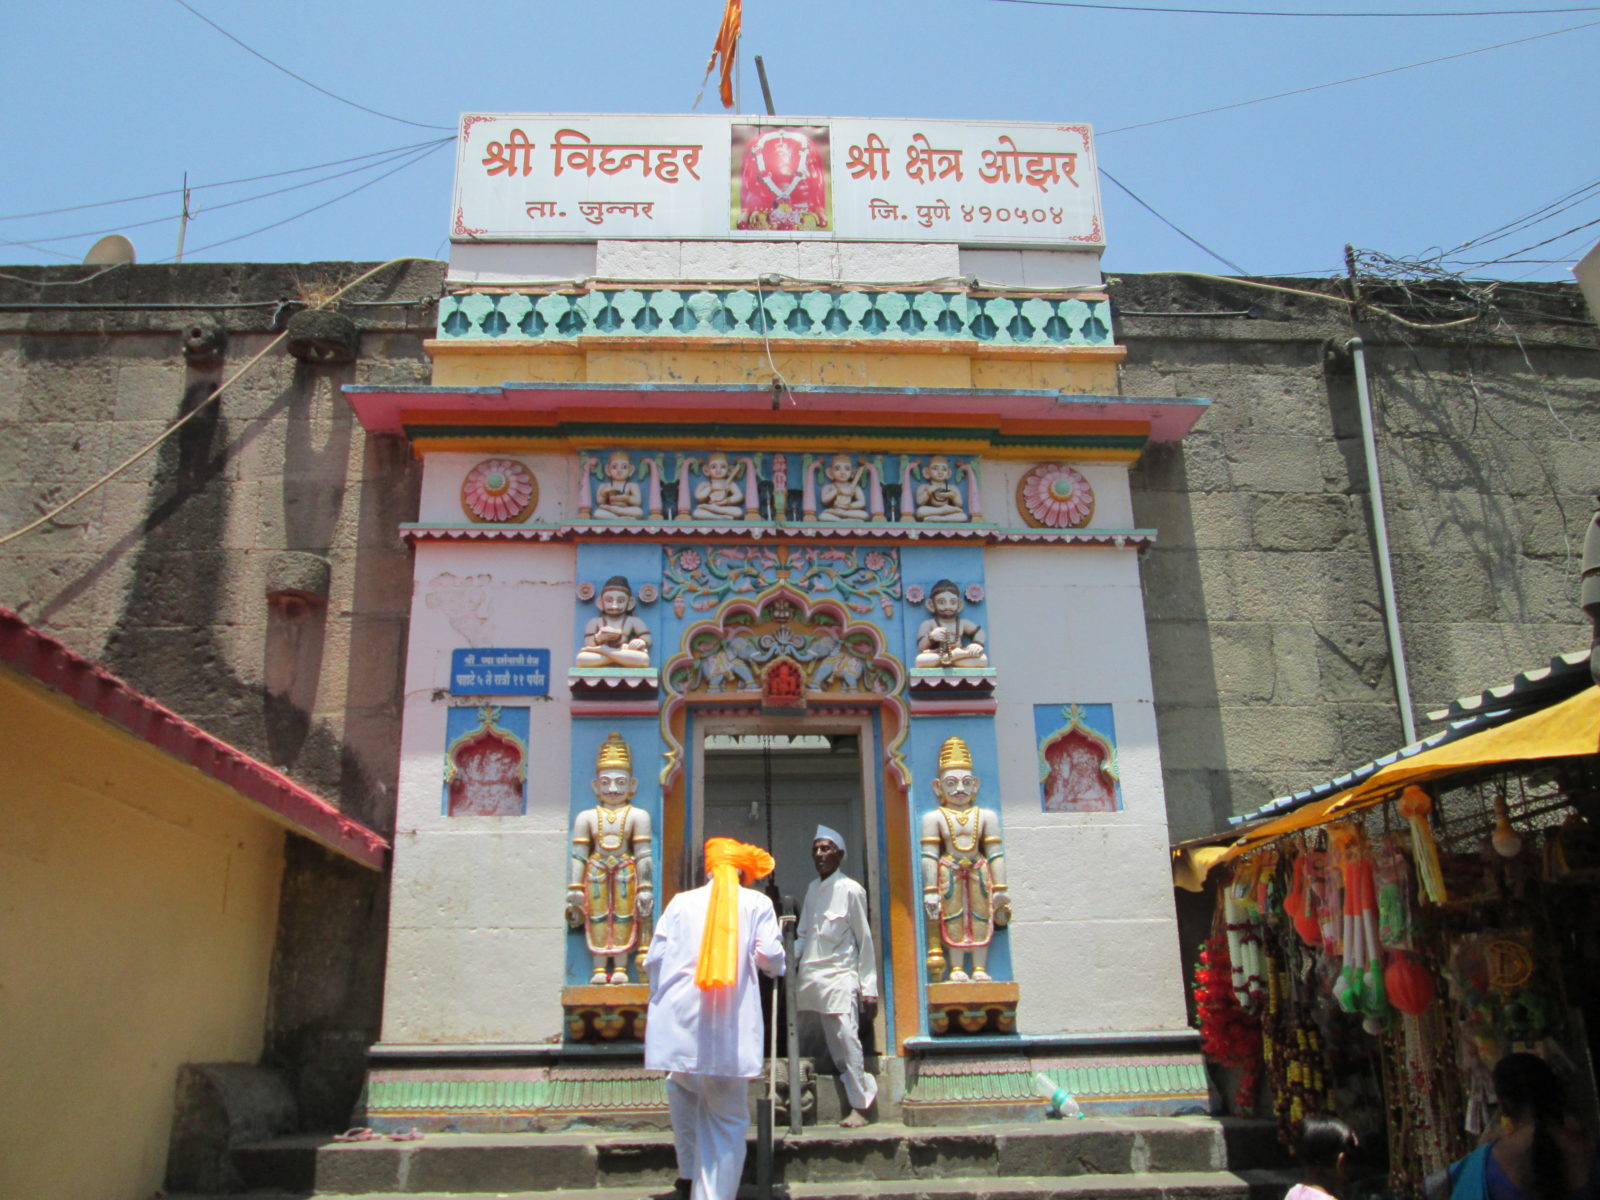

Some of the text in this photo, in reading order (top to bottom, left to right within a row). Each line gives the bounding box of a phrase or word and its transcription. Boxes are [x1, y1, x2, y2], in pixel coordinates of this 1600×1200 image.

[481, 128, 704, 184] श्री विघ्नहर
[845, 132, 1080, 193] श्री क्षेत्र ओझर
[525, 201, 655, 225] ता. जुन्नर
[868, 198, 1064, 228] जि. पुणे ४१०५०४
